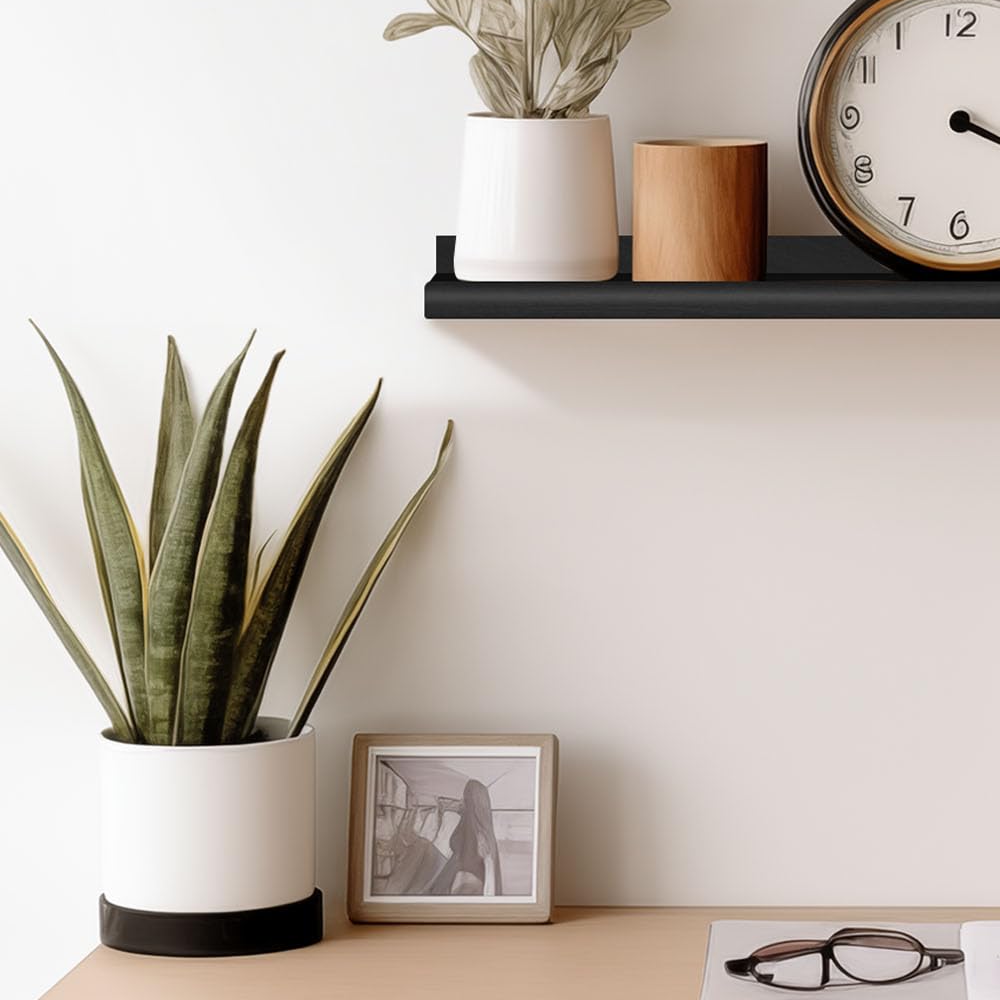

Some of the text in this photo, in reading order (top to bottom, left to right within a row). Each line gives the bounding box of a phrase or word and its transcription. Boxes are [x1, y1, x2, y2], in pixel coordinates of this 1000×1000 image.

[945, 10, 978, 37] 12
[898, 196, 916, 226] 7
[949, 210, 970, 240] 6
